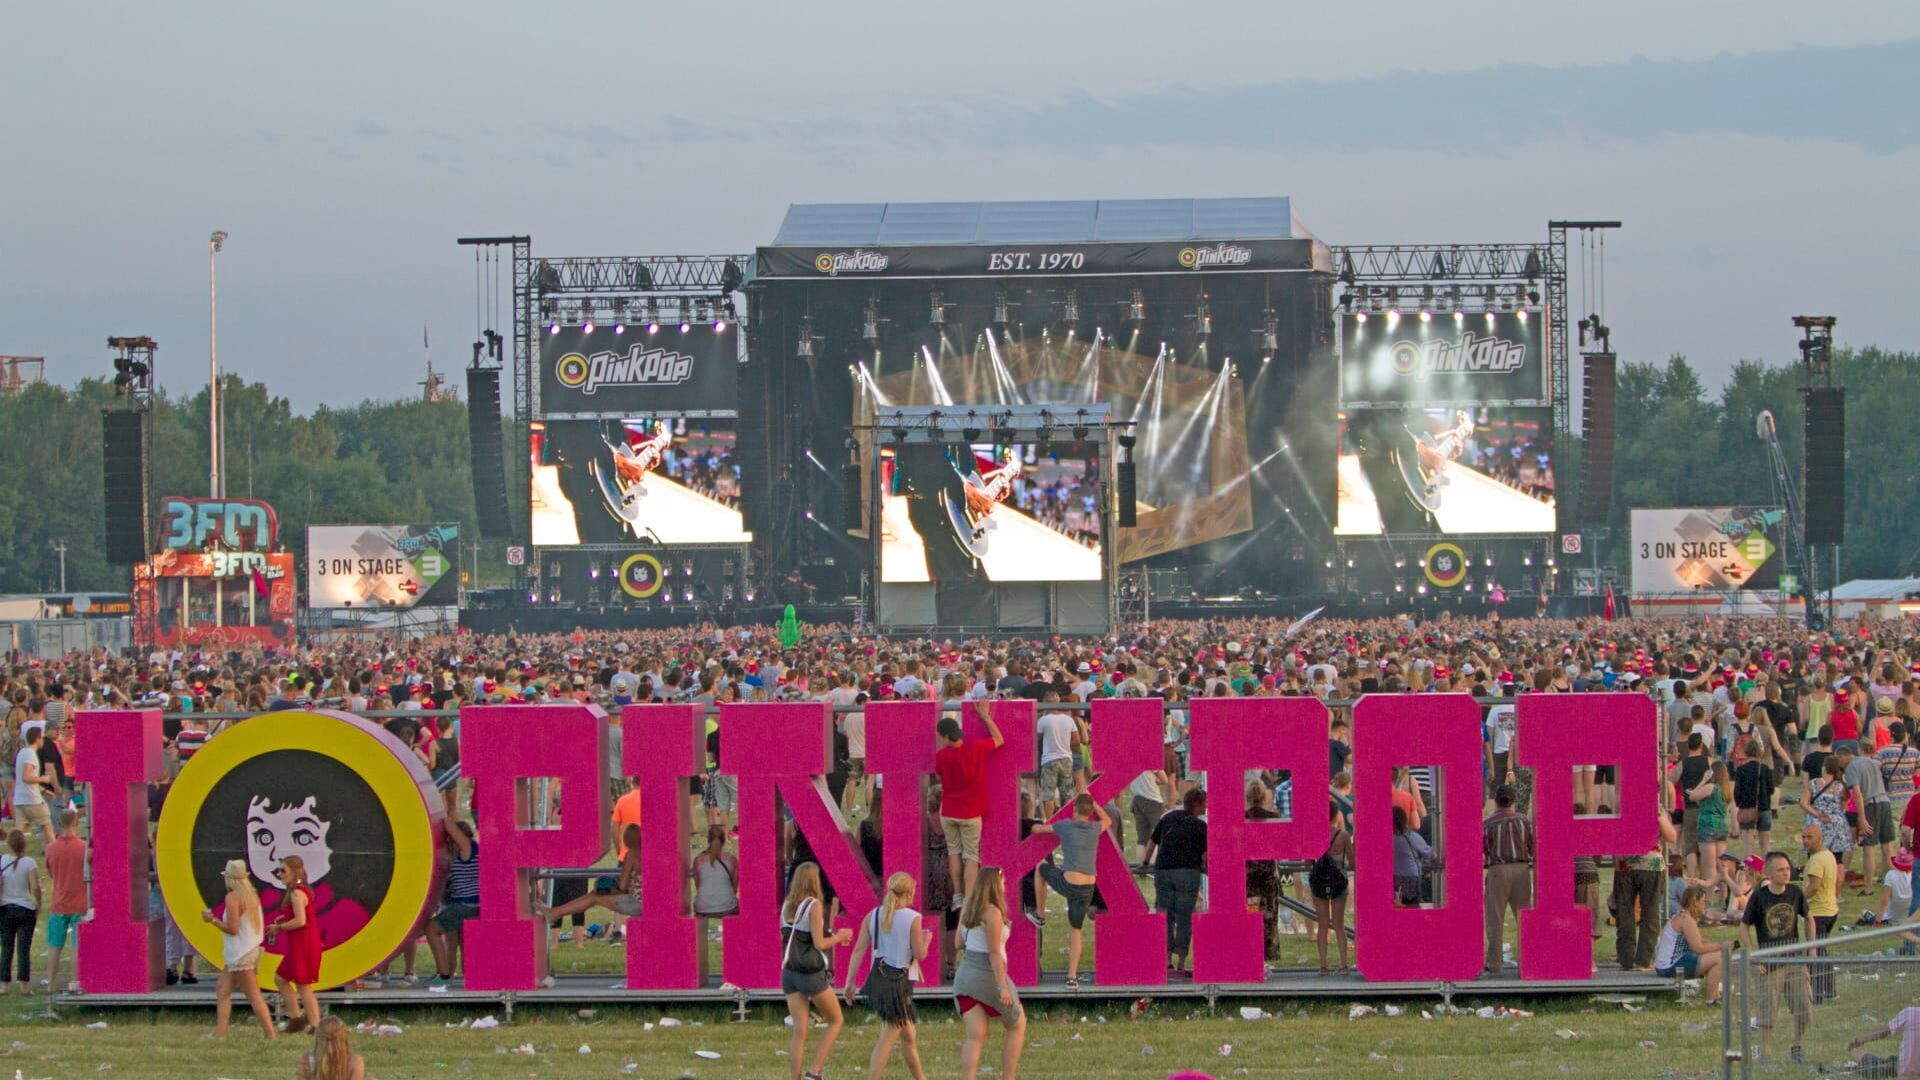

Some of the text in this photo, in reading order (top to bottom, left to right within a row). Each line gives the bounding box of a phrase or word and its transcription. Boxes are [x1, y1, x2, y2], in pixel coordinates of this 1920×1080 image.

[987, 252, 1085, 270] EST. 1970
[167, 501, 269, 549] 3FM
[1641, 541, 1728, 559] 3 ON STAGE
[213, 551, 266, 577] 3FM
[318, 558, 404, 575] 3 ON STAGE
[461, 693, 1658, 992] PINKPOP
